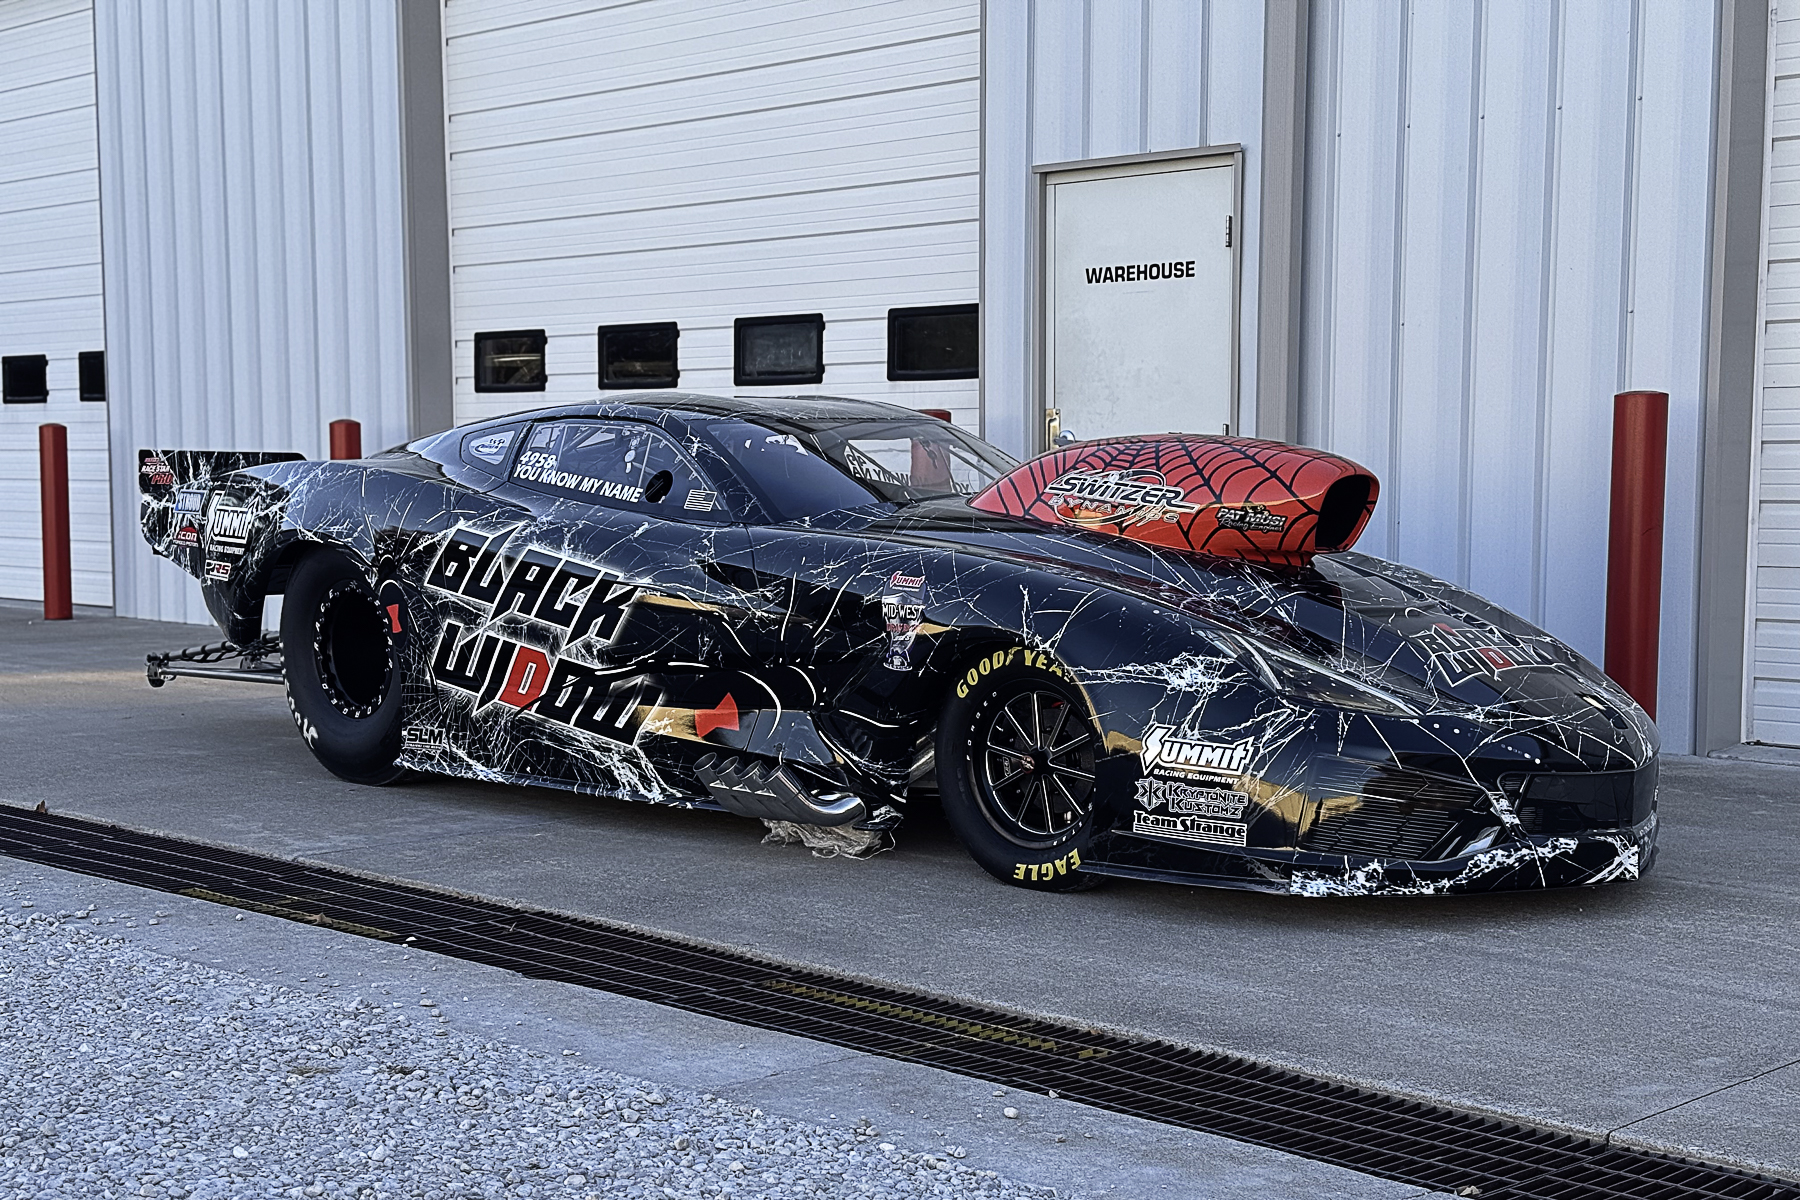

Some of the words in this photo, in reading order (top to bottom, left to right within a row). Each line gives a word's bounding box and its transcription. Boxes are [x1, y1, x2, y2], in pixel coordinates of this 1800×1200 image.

[1085, 260, 1195, 284] WAREHOUSE
[520, 451, 557, 469] 4958
[514, 463, 541, 481] YOU
[538, 469, 582, 489] KNOW
[579, 476, 603, 494] MY
[600, 481, 644, 503] NAME
[1045, 476, 1199, 513] SWITZER
[1216, 508, 1245, 520] PAT
[1244, 513, 1286, 526] MUSI
[424, 520, 641, 651] BLACK
[890, 571, 926, 588] SUMMIT
[882, 604, 926, 619] MID-WEST
[428, 619, 666, 747] WIDOW
[406, 727, 444, 745] SLM
[1141, 724, 1254, 775] SUMMIT
[1153, 768, 1185, 779] RACING
[1187, 772, 1240, 785] EQUIPMENT
[1167, 781, 1248, 806] KRYPTONITE
[1168, 797, 1243, 818] KUSTOMZ
[1135, 812, 1178, 829] Team
[1179, 816, 1246, 838] Strange
[1013, 848, 1082, 881] EAGLE
